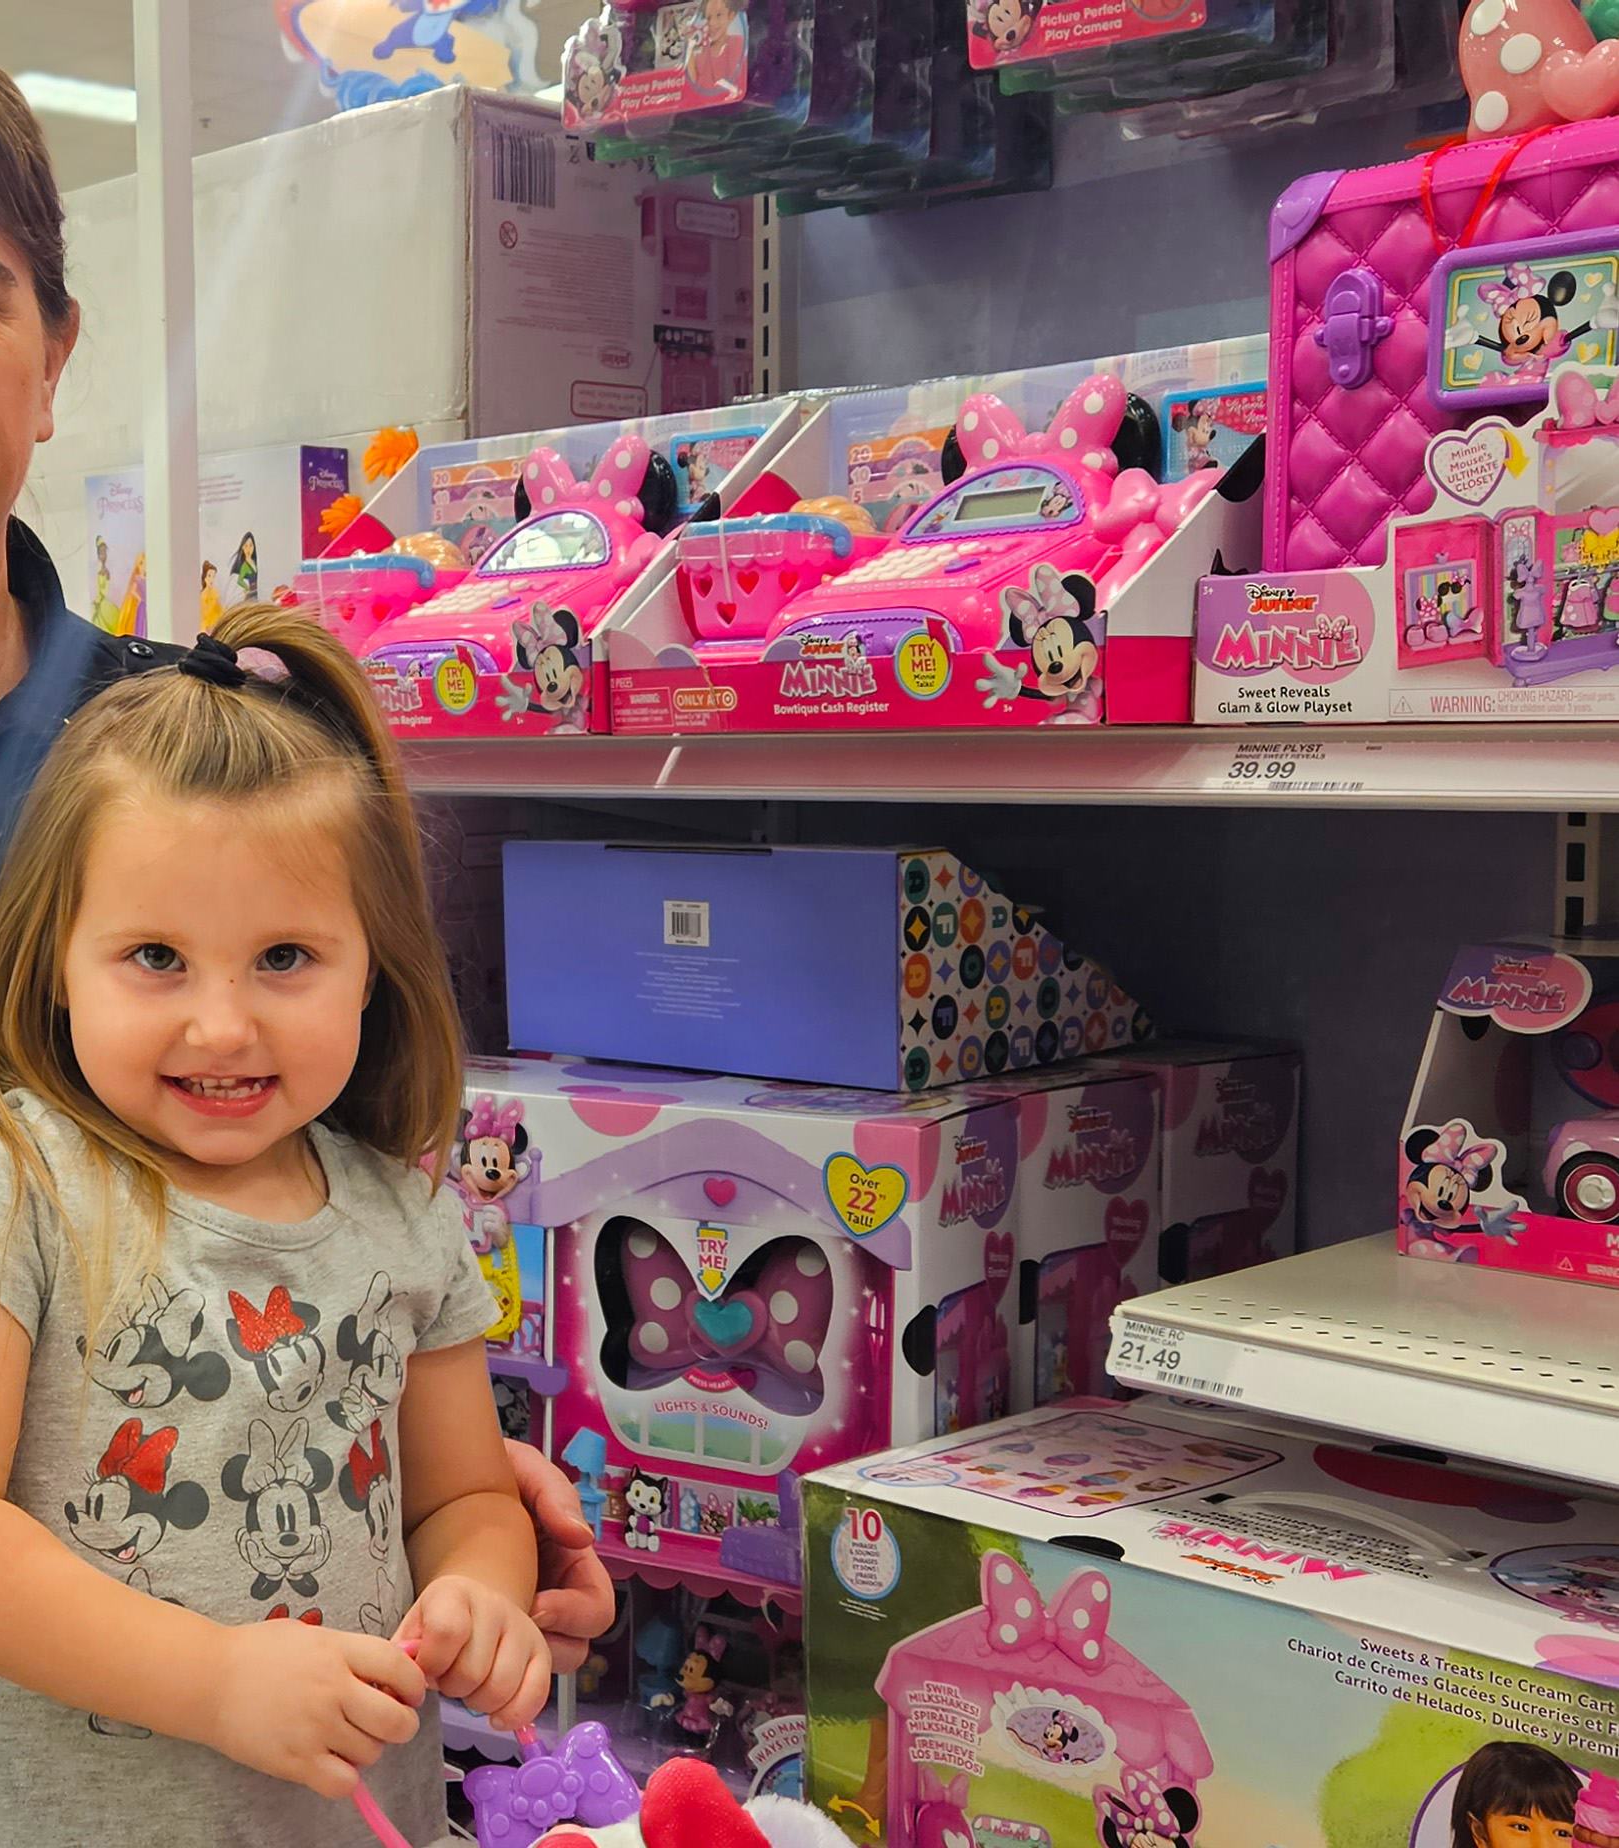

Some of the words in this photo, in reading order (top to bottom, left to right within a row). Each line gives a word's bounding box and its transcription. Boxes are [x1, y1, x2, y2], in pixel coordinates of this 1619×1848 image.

[1040, 12, 1081, 27] Picture
[1083, 2, 1126, 19] Perfect
[1045, 28, 1071, 41] Play
[1073, 18, 1123, 36] Camera
[1451, 443, 1487, 460] Minnie
[1450, 452, 1493, 472] Mouse's
[1447, 460, 1499, 484] ULTIMATE
[1455, 473, 1495, 492] CLOSET
[1203, 586, 1214, 596] 3+
[1245, 584, 1295, 599] Disney
[909, 643, 935, 657] TRY
[1212, 620, 1363, 670] MINNIE
[445, 666, 465, 679] TRY
[911, 658, 936, 672] ME!
[446, 679, 466, 692] ME!
[780, 661, 878, 698] MINNIE
[676, 694, 704, 707] ONLY
[707, 693, 721, 706] AT
[1238, 687, 1276, 698] Sweet
[1280, 686, 1331, 698] Reveals
[1430, 695, 1496, 713] WARNING:
[1497, 690, 1536, 703] CHOKING
[774, 703, 819, 716] Bowtique
[821, 702, 845, 714] Cash
[846, 701, 890, 715] Register
[1218, 702, 1250, 714] Glam
[1254, 702, 1263, 713] &
[1266, 702, 1300, 713] Glow
[1304, 701, 1353, 717] Playset
[1237, 744, 1282, 754] MINNIE
[1283, 744, 1324, 753] PLYST
[1228, 761, 1296, 779] 39.99
[1448, 976, 1568, 1013] MINNIE
[850, 1173, 881, 1190] Over
[847, 1211, 873, 1228] Tall!
[697, 1239, 728, 1255] TRY
[698, 1254, 728, 1271] ME!
[1123, 1332, 1149, 1342] MINNIE
[1150, 1336, 1160, 1345] RC
[1161, 1338, 1178, 1348] CAR
[1125, 1321, 1166, 1338] MINNIE
[1168, 1329, 1186, 1341] RC
[1118, 1341, 1181, 1370] 21.49
[654, 1400, 697, 1414] LIGHTS
[701, 1402, 709, 1413] &
[712, 1404, 769, 1430] SOUNDS!
[846, 1509, 882, 1542] 10
[851, 1541, 878, 1550] PHRASES
[852, 1557, 878, 1566] PHRASES
[1287, 1638, 1343, 1664] Chariot
[1347, 1654, 1366, 1670] de
[1370, 1660, 1428, 1686] Crèmes
[1433, 1676, 1496, 1705] Glacées
[1500, 1694, 1580, 1726] Sucreries
[1585, 1719, 1602, 1733] et
[1360, 1638, 1415, 1662] Sweets
[1419, 1653, 1430, 1667] &
[1435, 1656, 1484, 1681] Treats
[1489, 1671, 1513, 1688] Ice
[1517, 1679, 1572, 1704] Cream
[1578, 1693, 1616, 1715] Cart
[925, 1683, 960, 1699] SWIRL
[908, 1692, 979, 1717] MILKSHAKES!
[1335, 1670, 1388, 1695] Carrito
[1392, 1687, 1412, 1702] de
[1416, 1691, 1486, 1724] Helados,
[1491, 1711, 1549, 1739] Dulces
[1553, 1729, 1562, 1746] y
[913, 1710, 958, 1726] SPIRALE
[961, 1719, 976, 1733] DE
[762, 1728, 777, 1742] SO
[777, 1721, 806, 1736] MAN
[908, 1721, 975, 1743] MILKSHAKES
[755, 1740, 783, 1764] WAYS
[784, 1734, 800, 1747] TO
[911, 1749, 931, 1760] LOS
[933, 1750, 984, 1775] BATIDOS!
